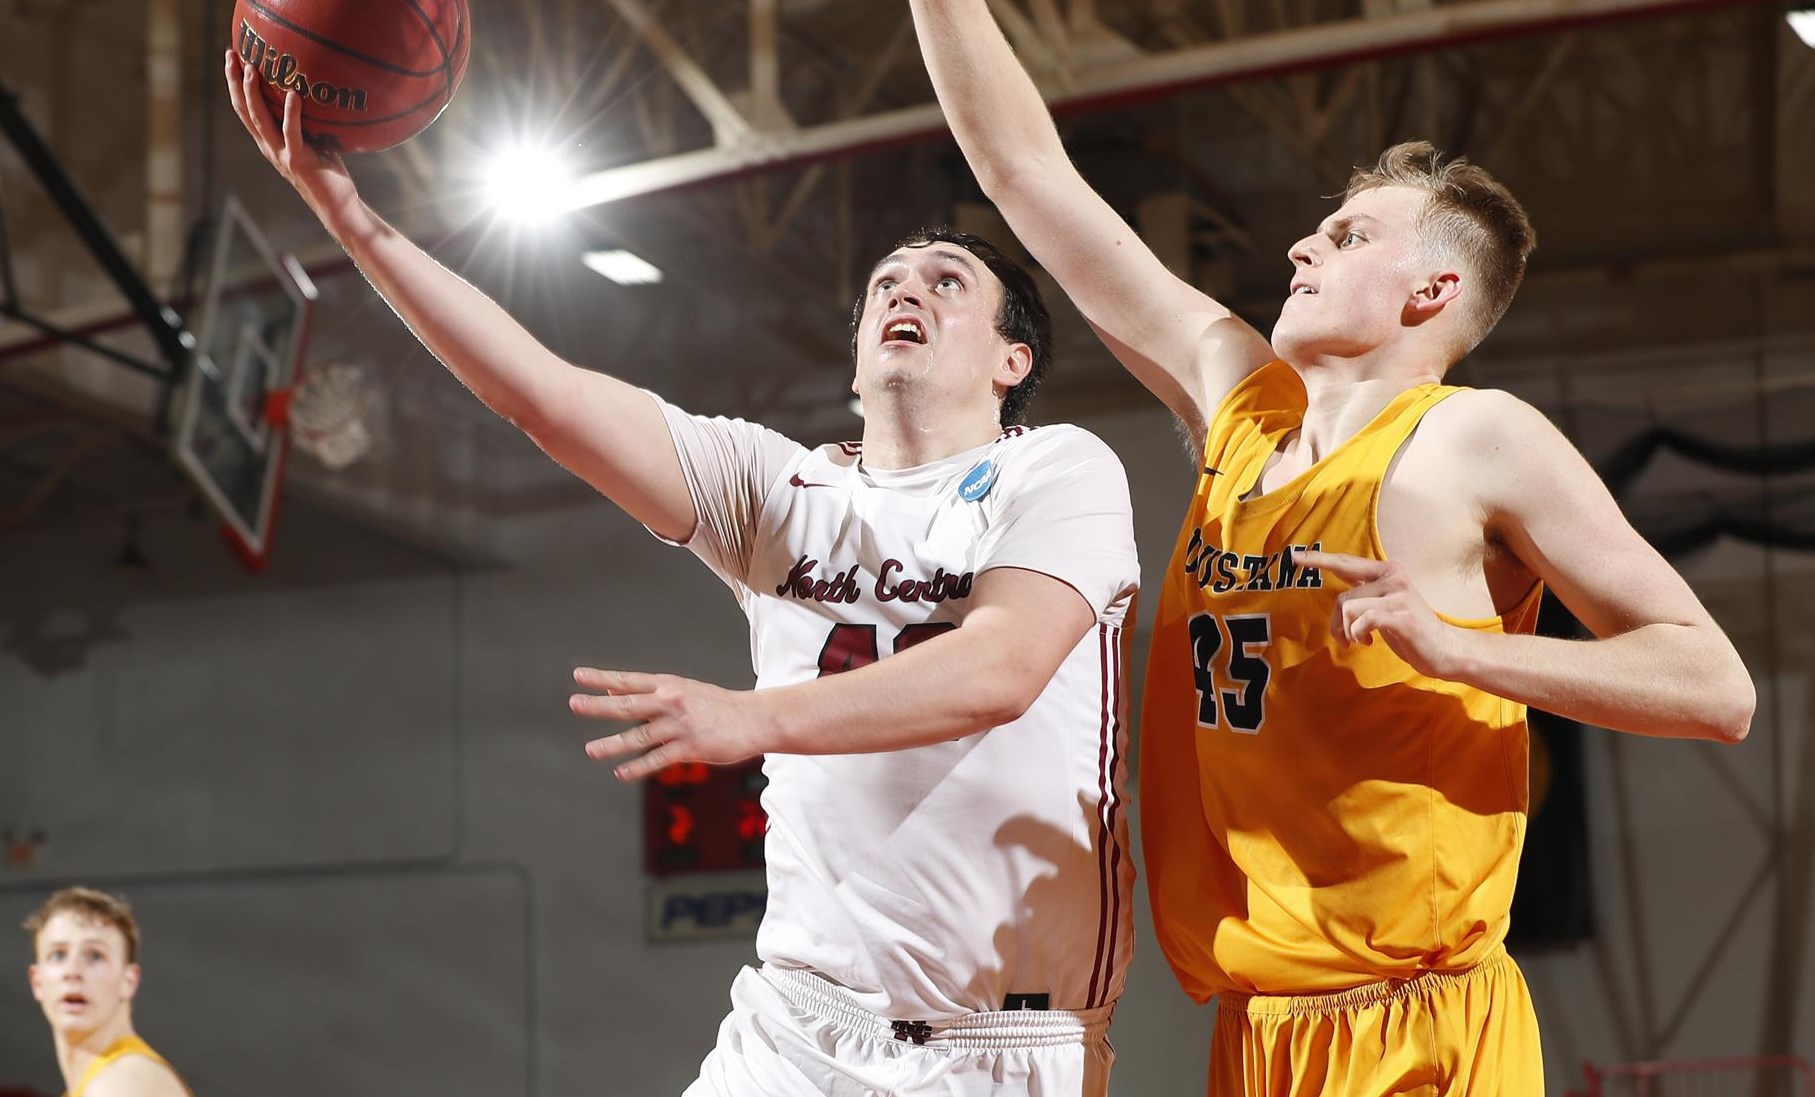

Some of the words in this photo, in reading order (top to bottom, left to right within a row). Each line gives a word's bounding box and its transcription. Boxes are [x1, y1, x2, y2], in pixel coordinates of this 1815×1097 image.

[238, 17, 368, 113] Wilson
[963, 467, 992, 497] NCAA
[776, 554, 861, 604] North
[875, 558, 974, 603] Centra
[1187, 609, 1272, 735] 45
